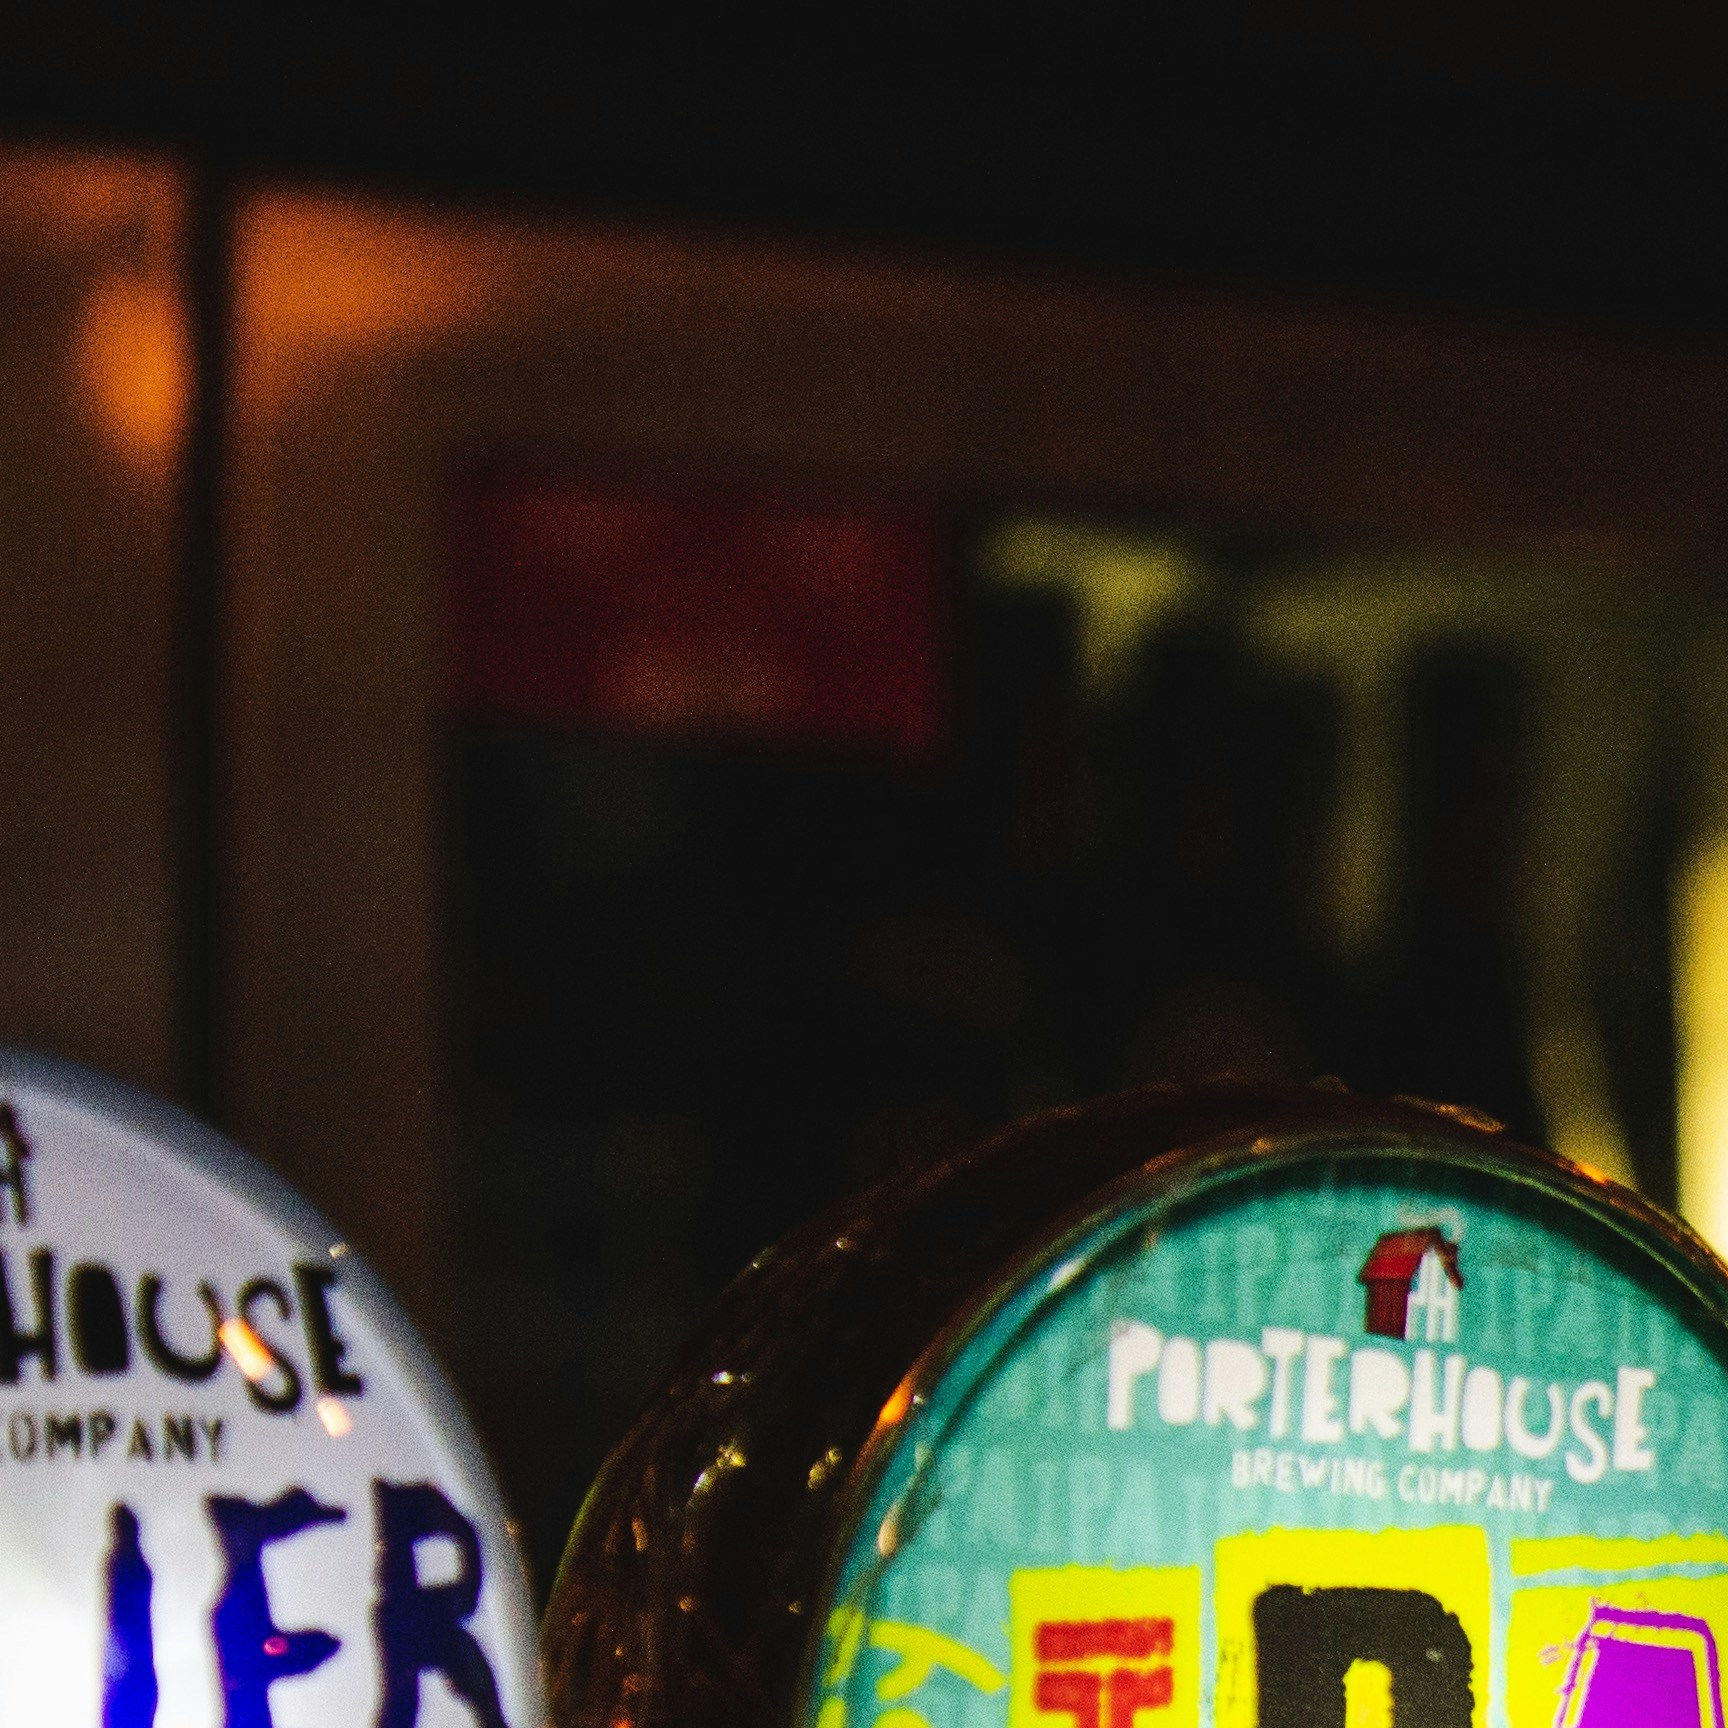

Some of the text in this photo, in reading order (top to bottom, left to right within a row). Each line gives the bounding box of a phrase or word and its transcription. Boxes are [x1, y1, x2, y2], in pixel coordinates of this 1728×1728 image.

[1106, 1316, 1656, 1485] PORTERHOUSE
[1231, 1448, 1554, 1514] BREWING COMPANY
